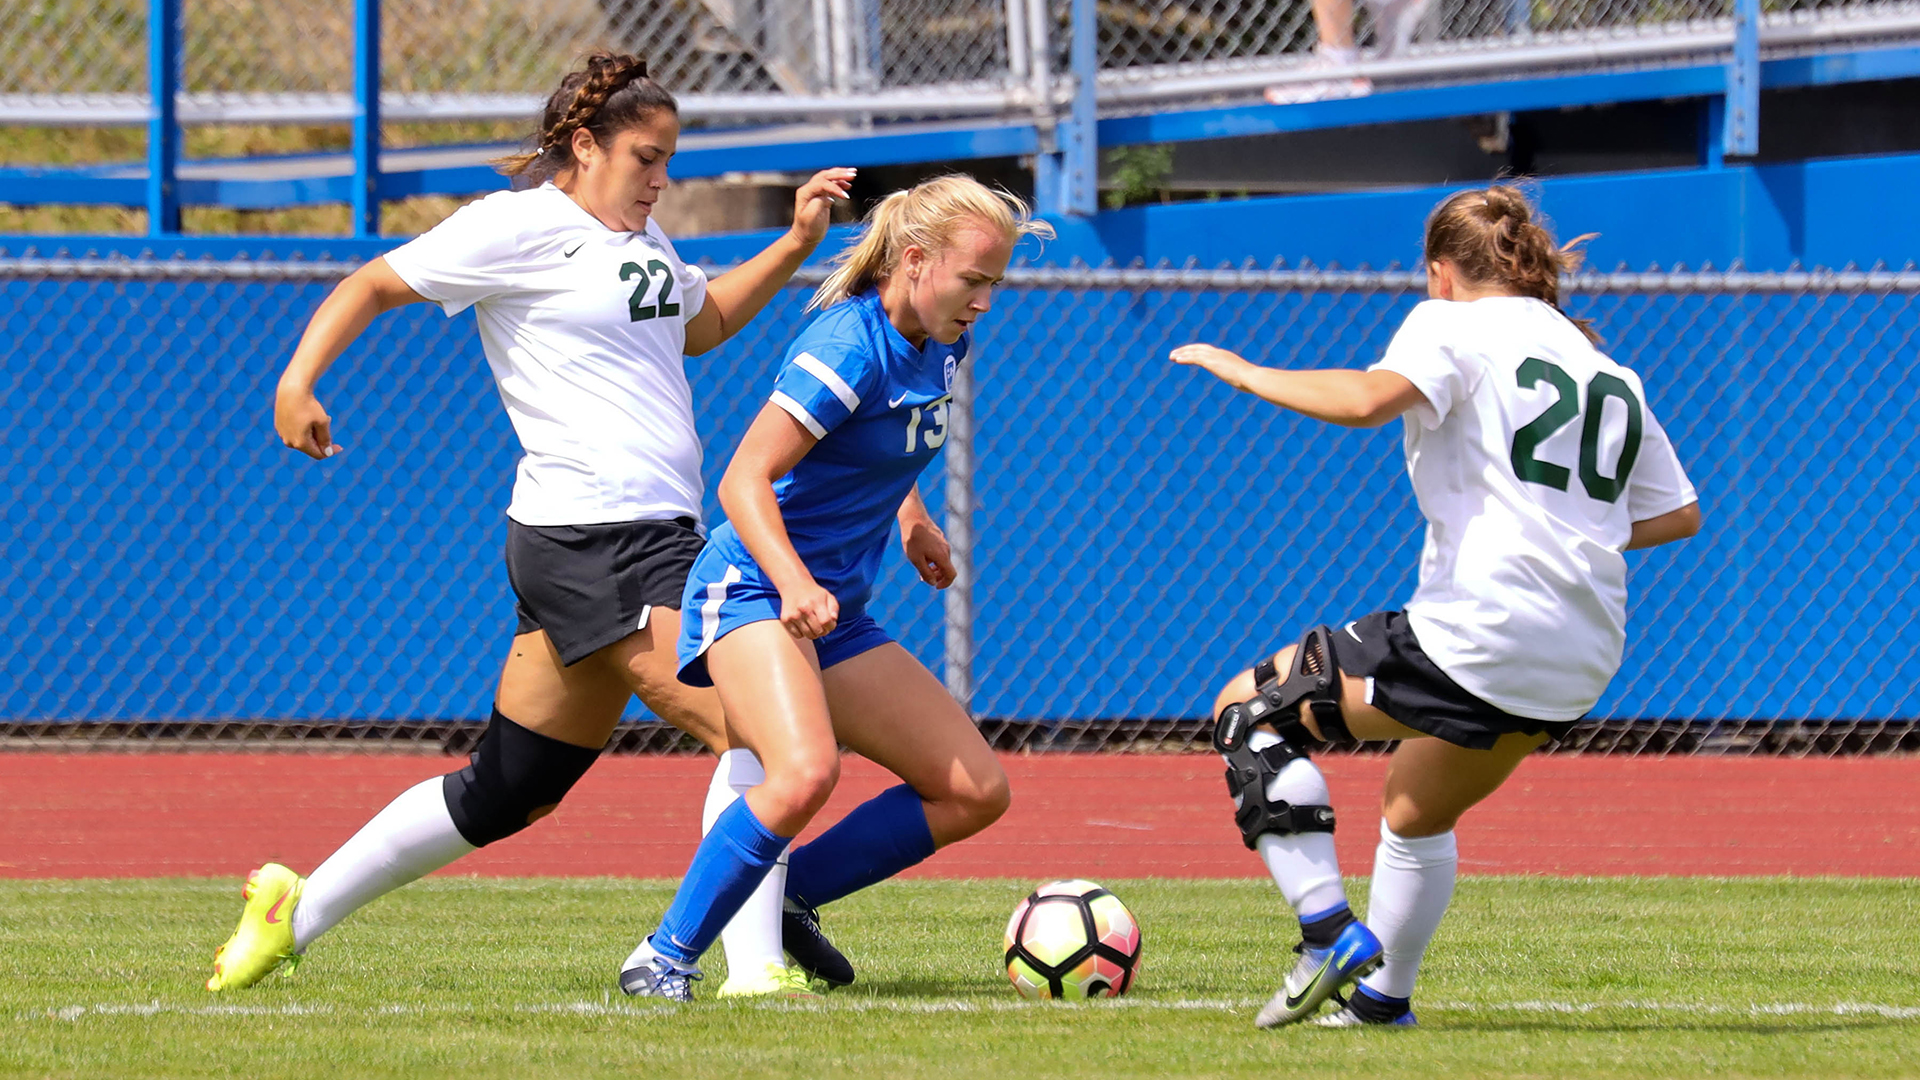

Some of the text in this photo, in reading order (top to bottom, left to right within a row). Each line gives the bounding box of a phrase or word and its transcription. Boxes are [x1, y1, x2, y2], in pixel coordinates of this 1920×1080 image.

[619, 259, 680, 322] 22
[905, 394, 953, 453] 13
[1511, 357, 1642, 504] 20
